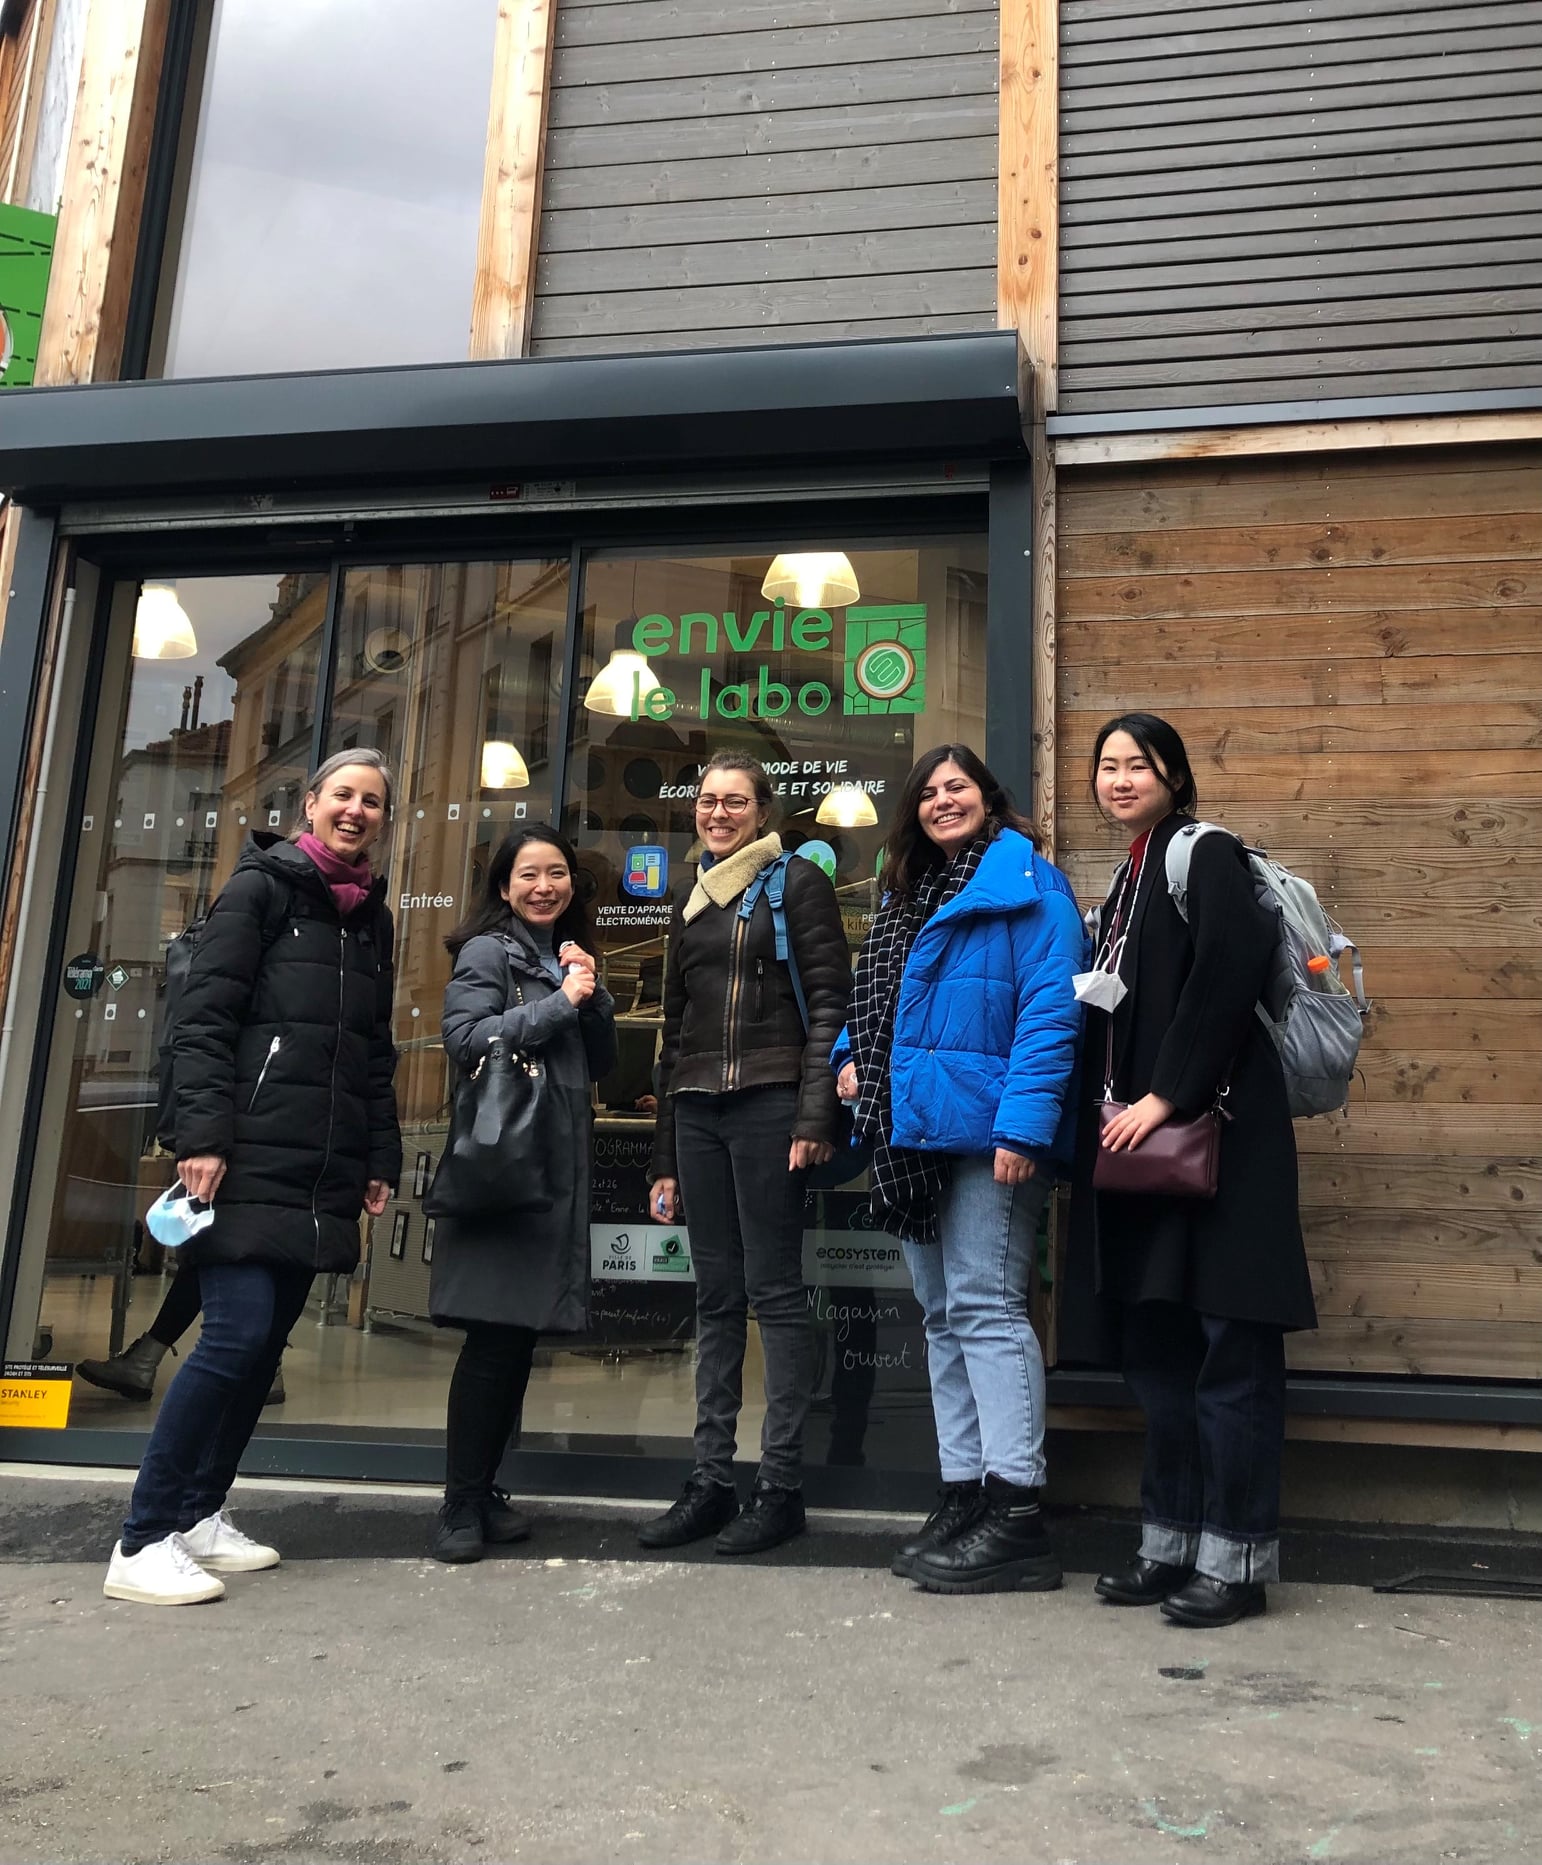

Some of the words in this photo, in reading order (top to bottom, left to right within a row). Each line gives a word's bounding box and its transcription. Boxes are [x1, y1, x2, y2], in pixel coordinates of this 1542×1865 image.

[632, 597, 833, 656] envie
[630, 671, 676, 721] le
[699, 665, 831, 720] labo
[802, 761, 821, 774] DE
[826, 760, 848, 773] VIE
[791, 782, 808, 795] ET
[812, 780, 885, 796] SOLIDAIRE
[400, 891, 454, 909] Entrée
[598, 906, 627, 915] VENTE
[628, 905, 673, 914] D'APPARE
[596, 915, 671, 926] ÉLECTROMÉNAG
[75, 978, 92, 990] 2021
[816, 1247, 900, 1261] ecosystem
[602, 1260, 636, 1271] PARIS
[806, 1284, 900, 1342] Magasin
[1, 1389, 47, 1399] STANLEY
